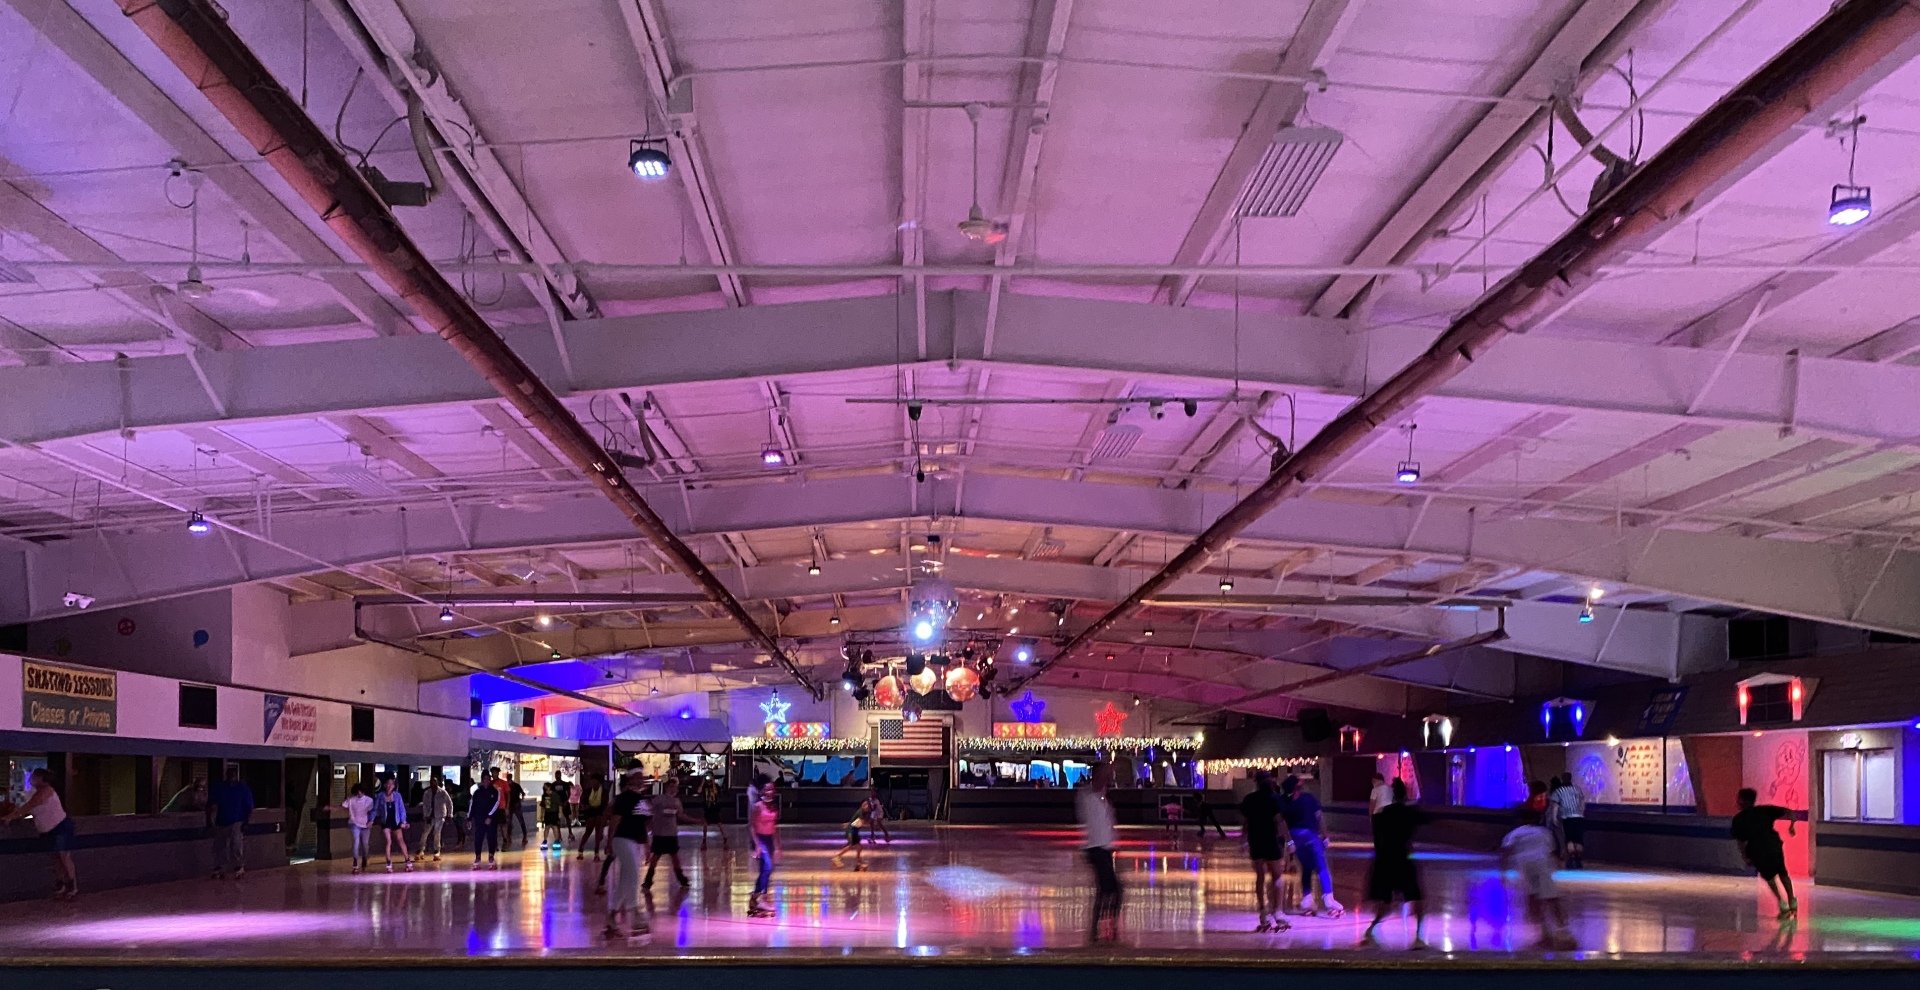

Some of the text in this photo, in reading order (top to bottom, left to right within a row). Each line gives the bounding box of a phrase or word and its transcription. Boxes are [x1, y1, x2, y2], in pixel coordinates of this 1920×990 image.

[27, 667, 113, 697] SKATING LESSONS
[68, 709, 80, 725] or
